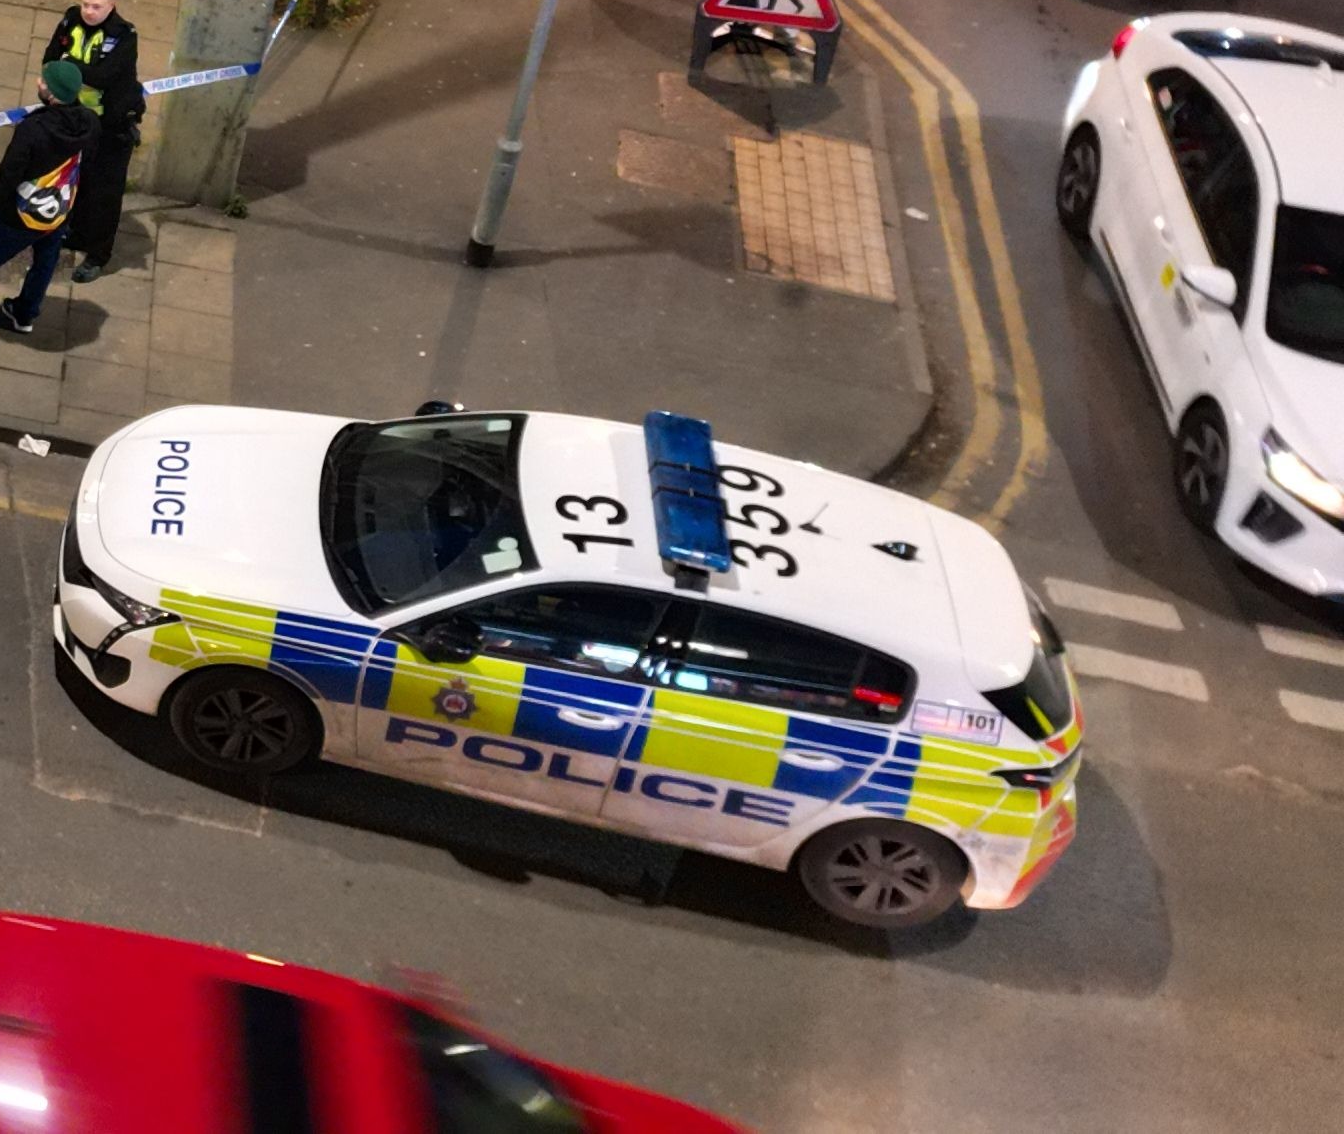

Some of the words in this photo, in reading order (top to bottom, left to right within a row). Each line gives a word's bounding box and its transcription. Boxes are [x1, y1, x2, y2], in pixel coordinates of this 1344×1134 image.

[151, 441, 191, 535] POLICE
[555, 495, 634, 553] 13
[718, 465, 799, 577] 359
[967, 714, 996, 731] 101
[385, 717, 795, 827] POLICE
